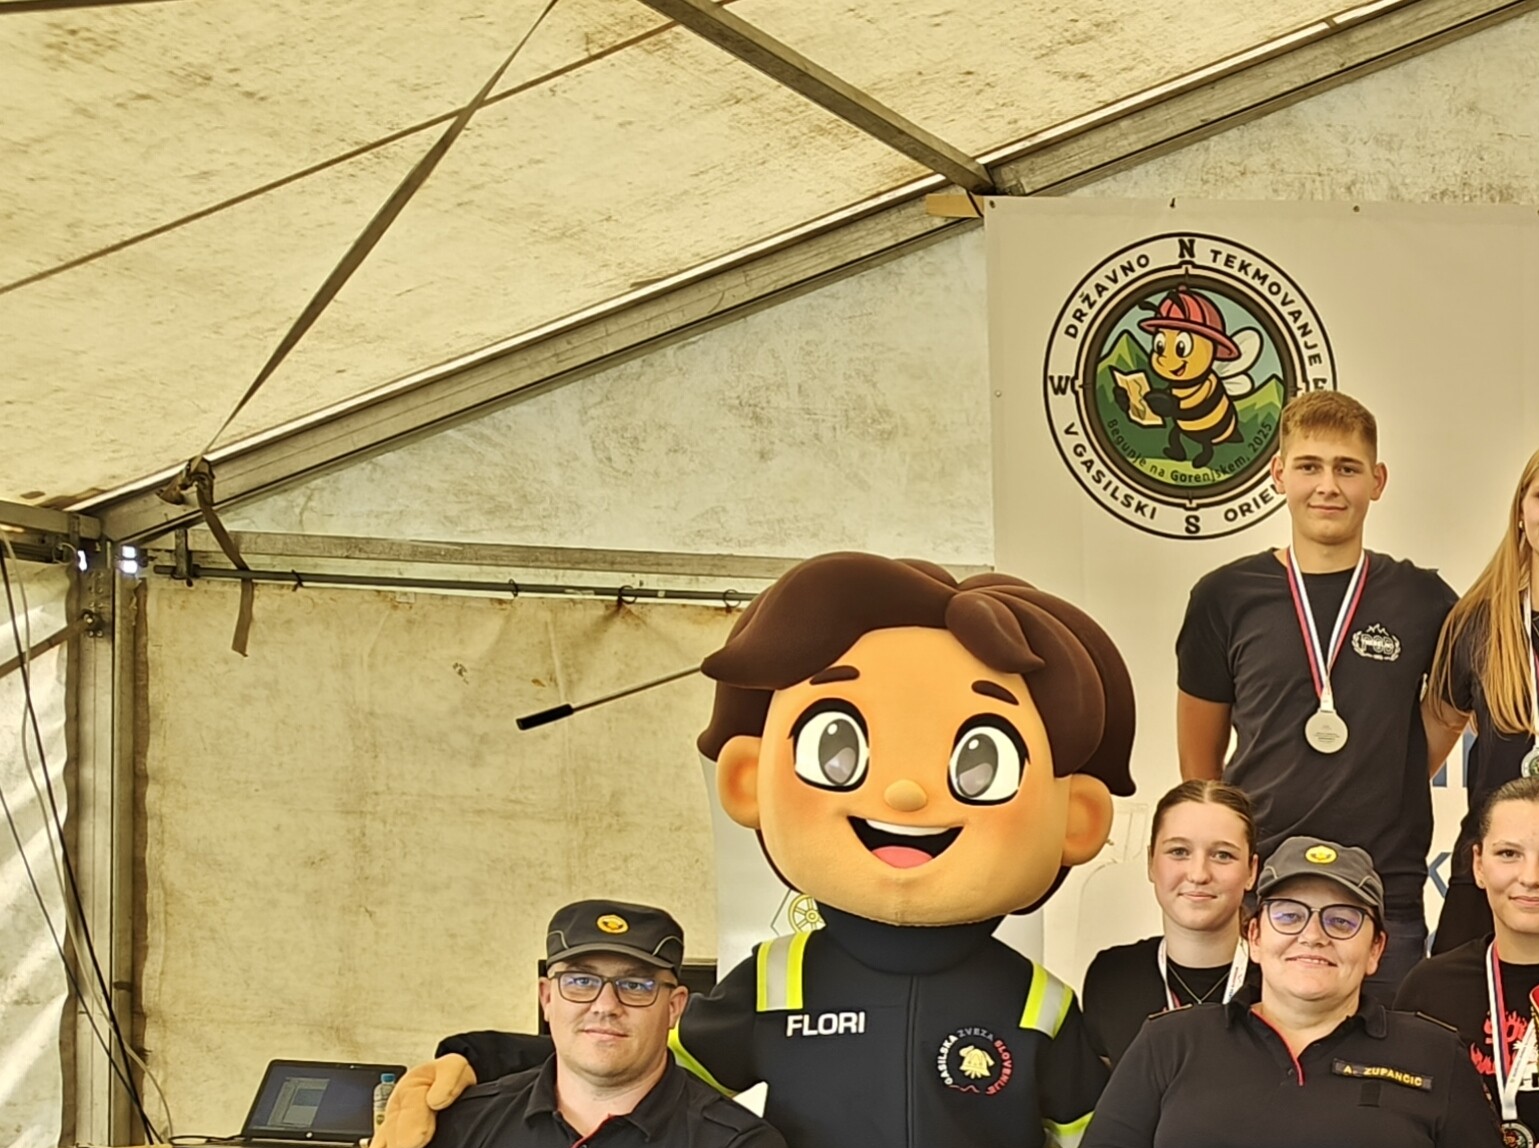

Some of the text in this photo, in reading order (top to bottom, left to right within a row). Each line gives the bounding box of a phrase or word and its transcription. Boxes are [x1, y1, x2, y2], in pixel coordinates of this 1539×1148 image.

[1178, 239, 1196, 259] N
[1064, 249, 1323, 367] DRŽAVNO TEKMOVANJE
[1049, 376, 1070, 396] W
[1107, 419, 1147, 468] Begunje
[1150, 464, 1166, 478] na
[1248, 421, 1273, 453] 2025
[1063, 422, 1157, 520] V GASILSKI
[1184, 515, 1201, 535] S
[786, 1011, 866, 1037] FLORI
[937, 1034, 959, 1085] GASILSKA
[957, 1027, 994, 1042] ZVEZA
